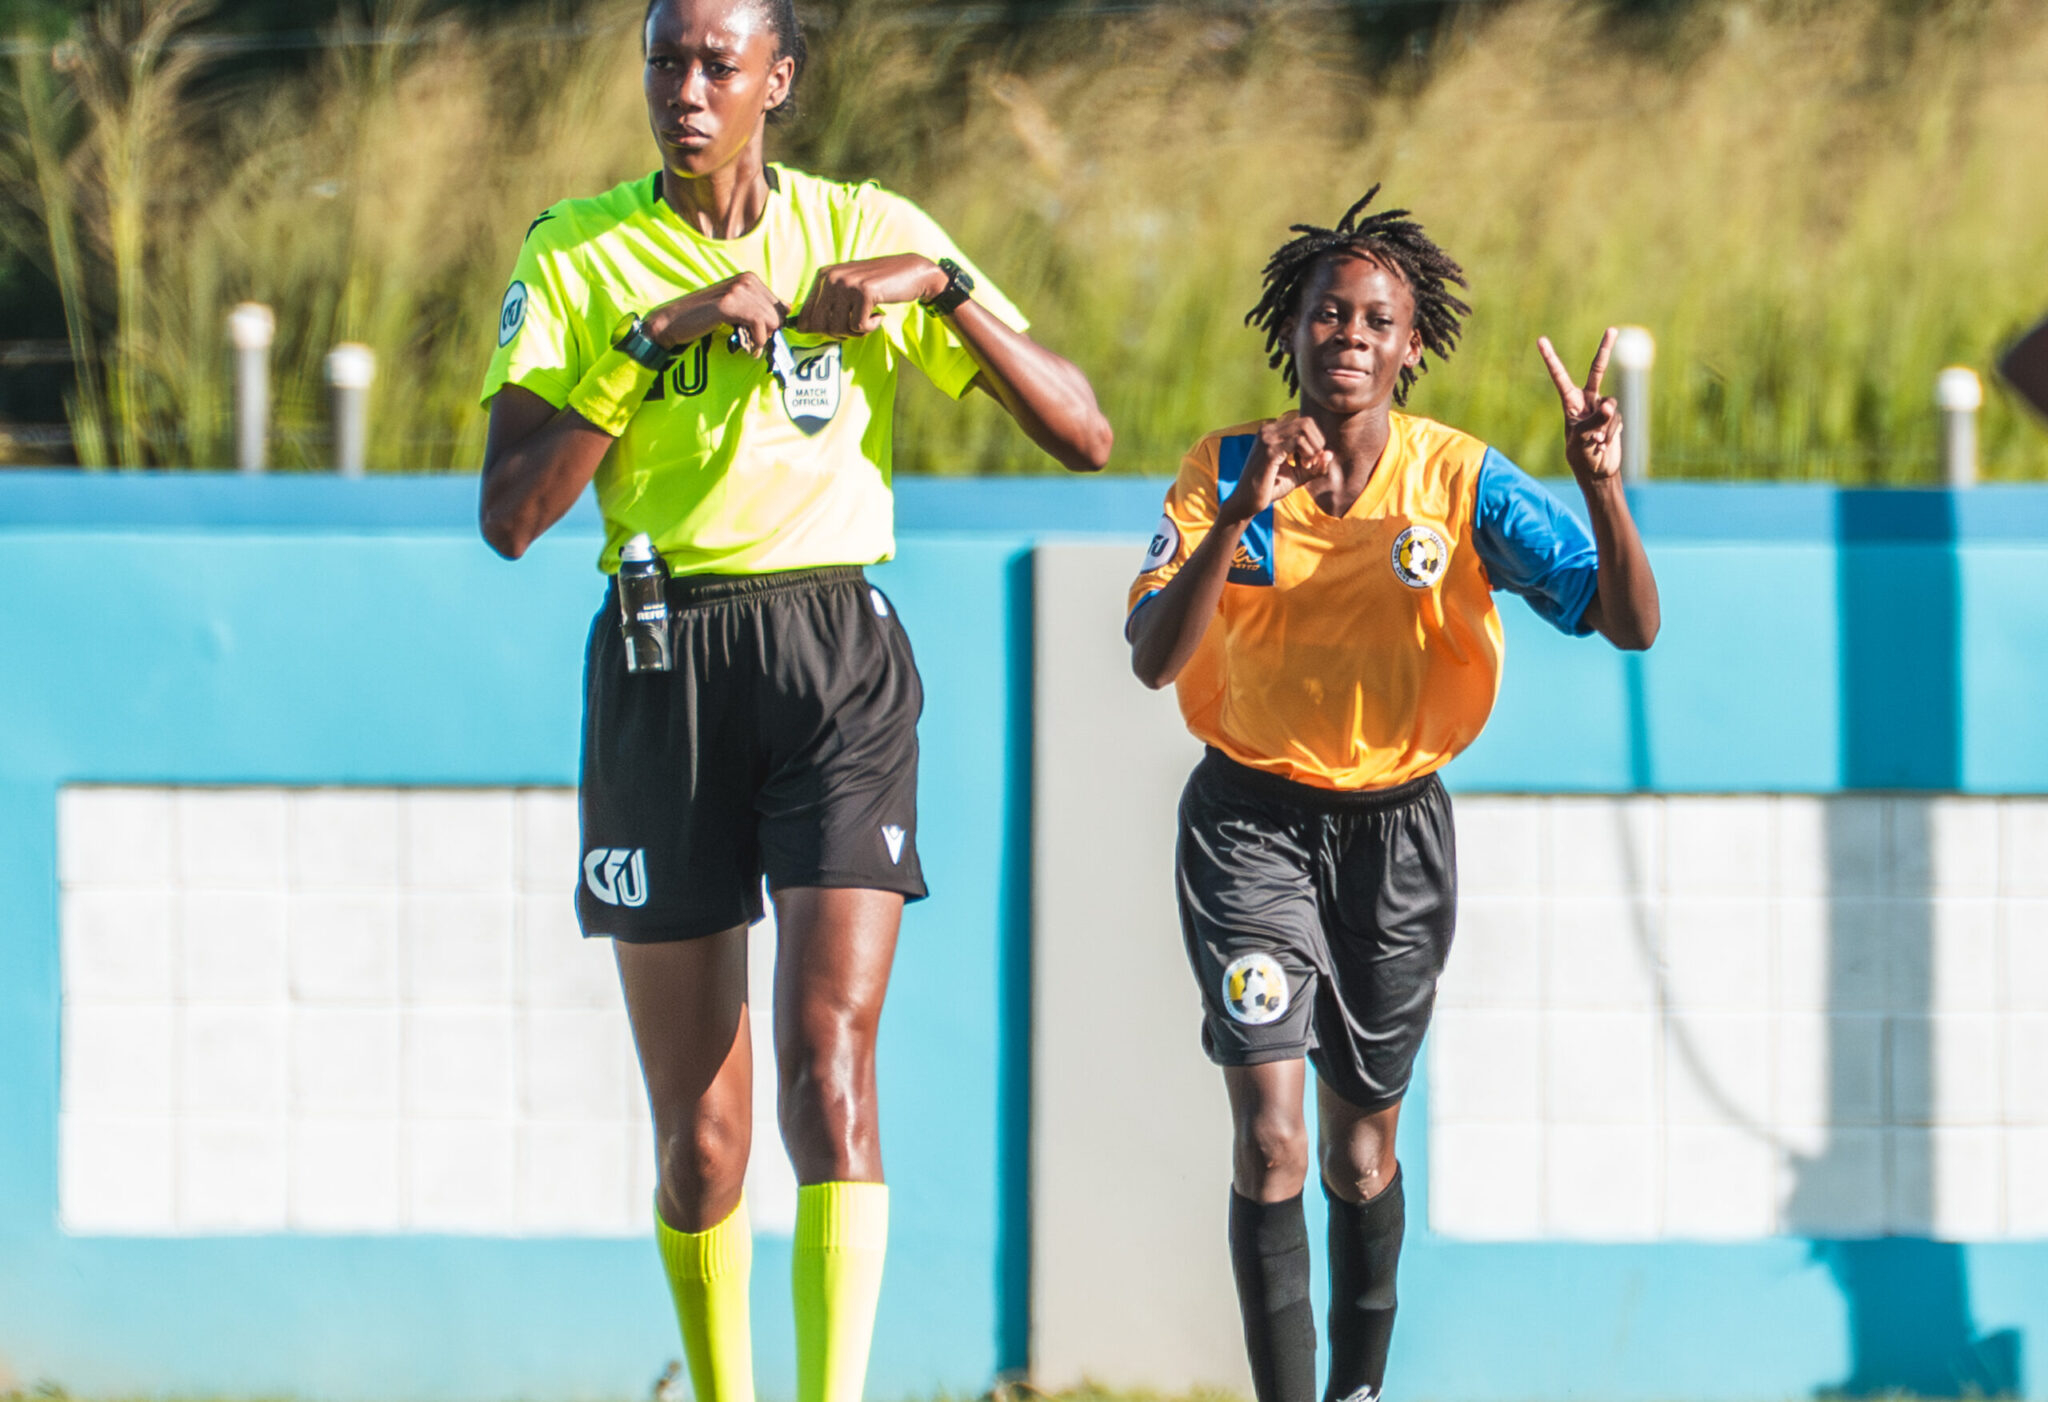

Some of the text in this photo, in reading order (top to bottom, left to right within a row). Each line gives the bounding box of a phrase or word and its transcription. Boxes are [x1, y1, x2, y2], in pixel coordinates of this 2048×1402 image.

[795, 387, 826, 398] MATCH
[792, 397, 829, 407] OFFICIAL
[583, 848, 648, 907] CFU
